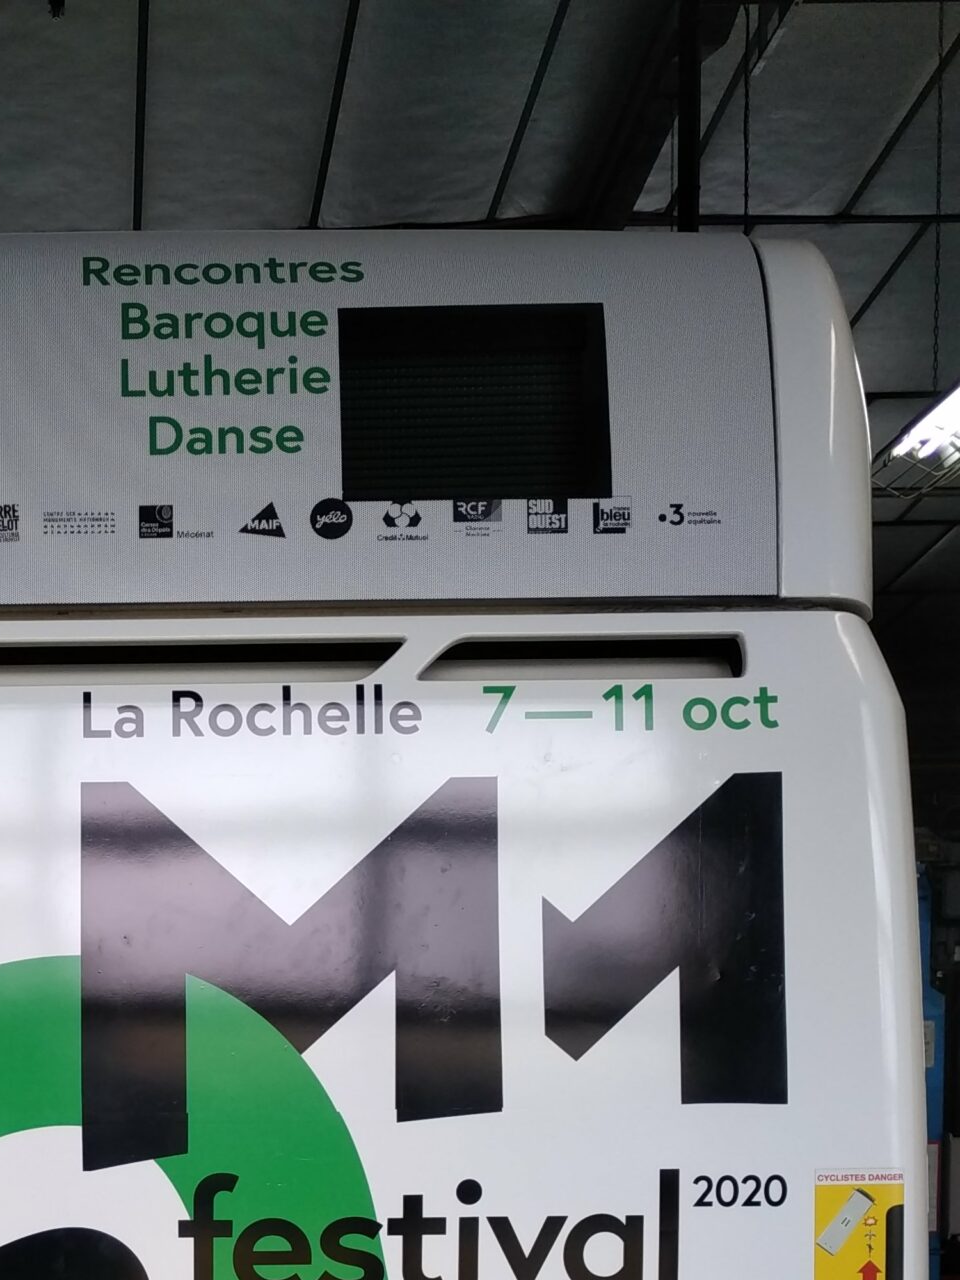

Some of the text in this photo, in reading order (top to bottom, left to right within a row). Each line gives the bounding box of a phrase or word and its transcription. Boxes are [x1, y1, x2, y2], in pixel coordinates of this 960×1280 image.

[82, 257, 365, 286] Rencontres
[121, 302, 328, 350] Baroque
[121, 354, 330, 398] Lutherie
[148, 416, 304, 456] Danse
[457, 502, 488, 514] RCF
[528, 499, 554, 514] SUD
[529, 514, 566, 528] OUEST
[601, 509, 630, 521] bleu
[247, 519, 280, 530] MAIF
[81, 684, 422, 739] La Rochelle
[682, 686, 779, 731] oct
[692, 1174, 788, 1208] 2020
[817, 1173, 903, 1182] CYCLISTES DANGER
